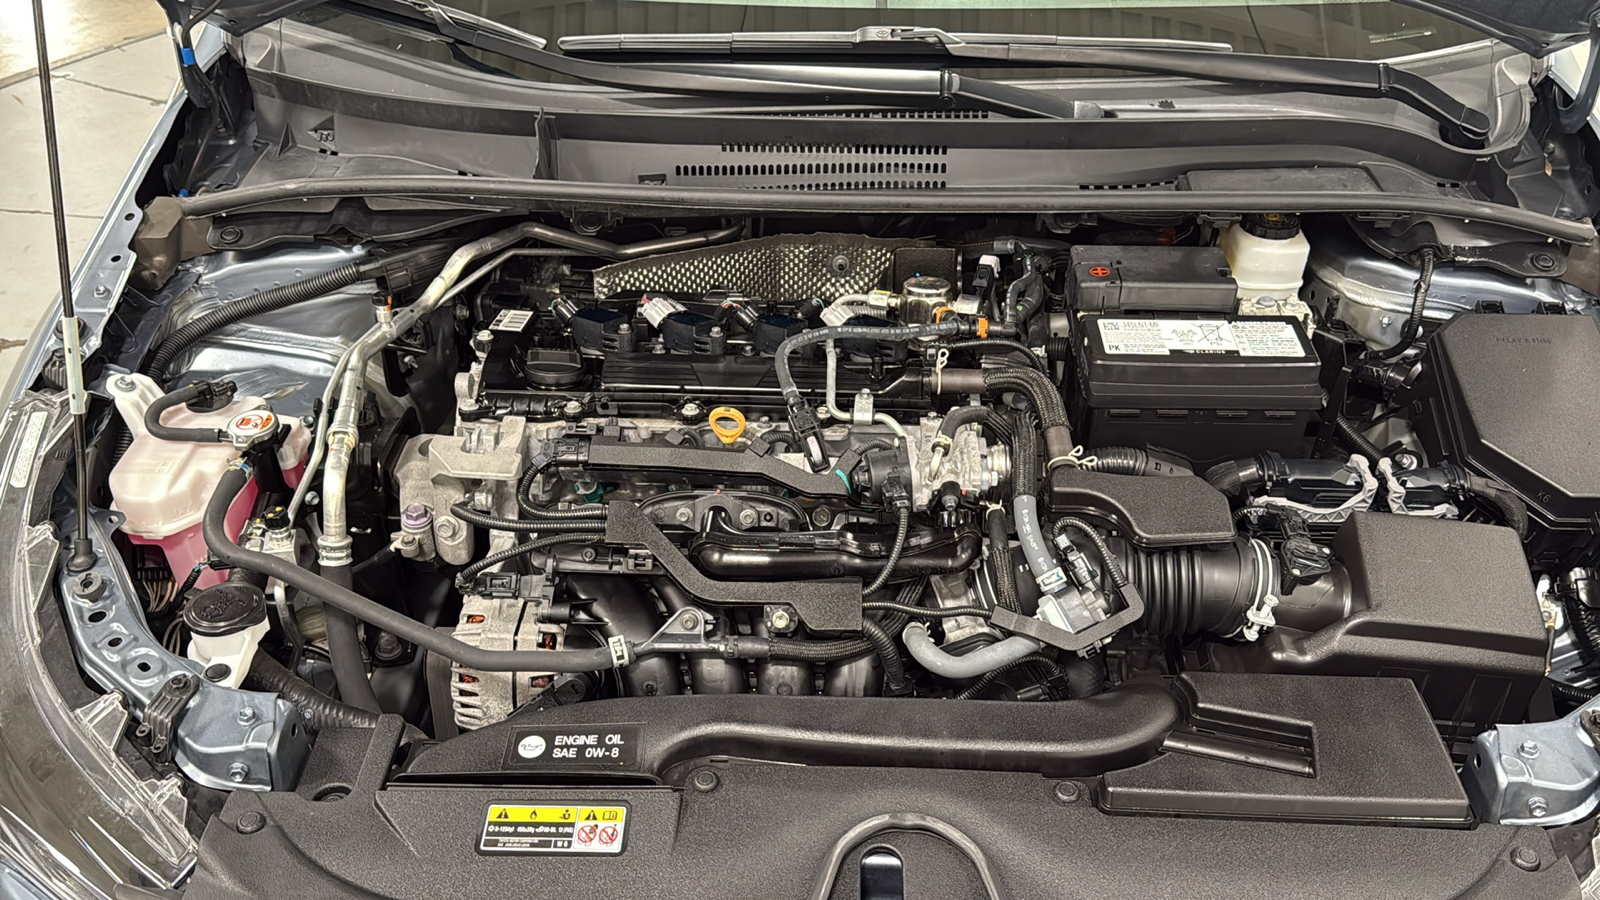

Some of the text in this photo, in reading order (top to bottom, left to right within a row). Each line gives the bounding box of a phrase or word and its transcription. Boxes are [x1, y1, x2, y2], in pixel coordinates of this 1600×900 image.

[1536, 490, 1552, 503] K6
[554, 733, 625, 746] ENGINE OIL
[552, 747, 619, 758] SAE 0W-8
